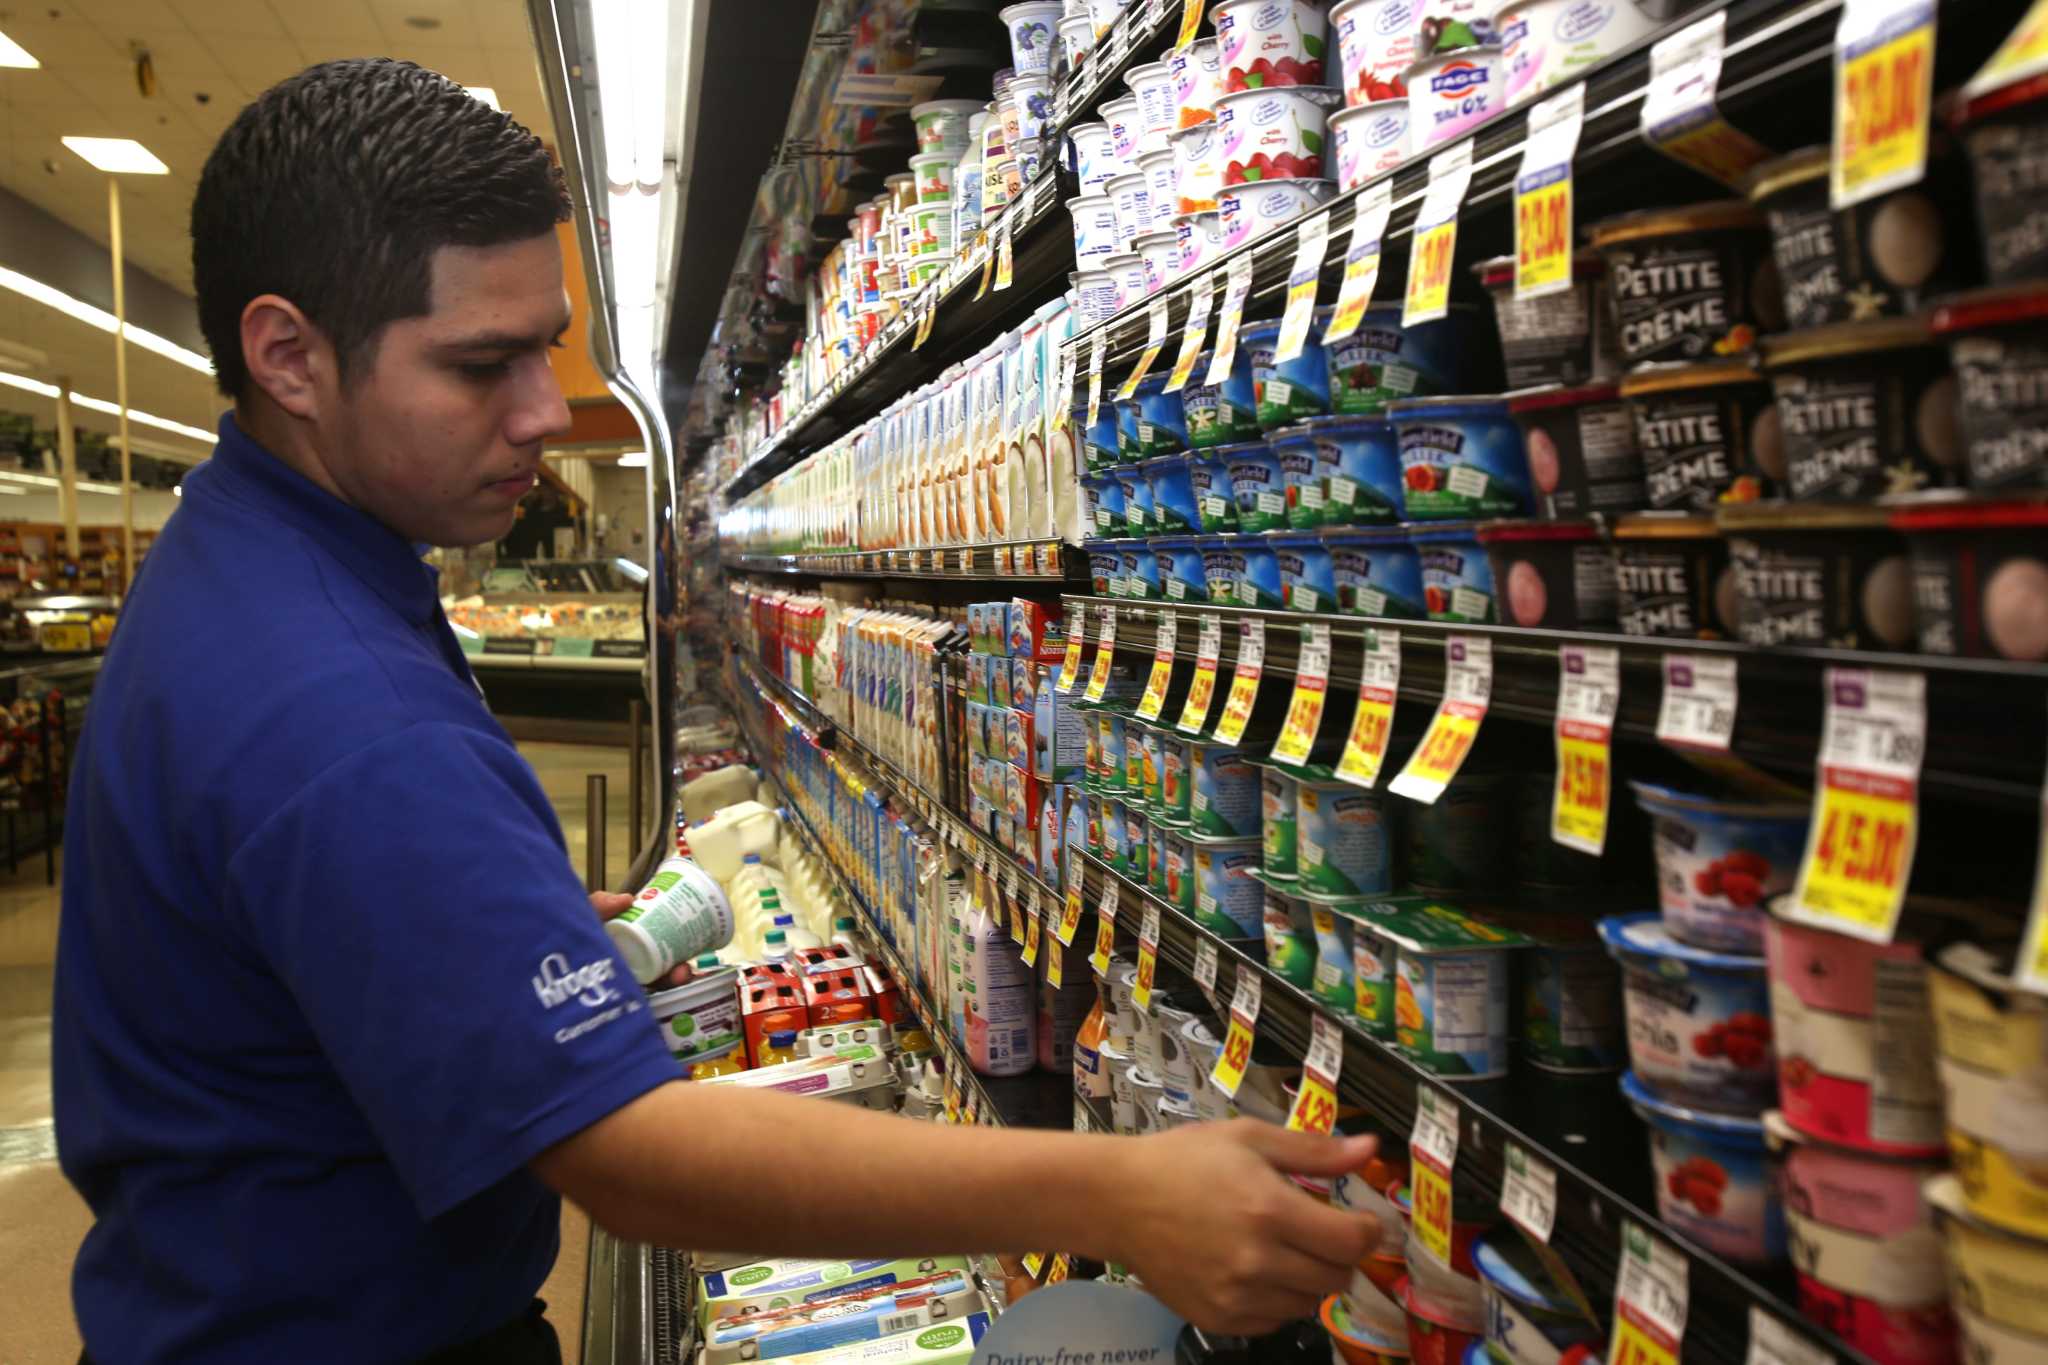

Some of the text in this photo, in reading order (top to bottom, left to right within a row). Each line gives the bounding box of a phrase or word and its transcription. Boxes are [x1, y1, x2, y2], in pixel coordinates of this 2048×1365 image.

[1261, 42, 1289, 51] Cherry
[1434, 70, 1487, 91] FAGE
[1461, 95, 1488, 115] 0%
[1260, 137, 1288, 146] Cherry
[1615, 260, 1722, 297] PETITE
[532, 952, 616, 1008] Kroger
[986, 1347, 1161, 1365] Dairy-free never
